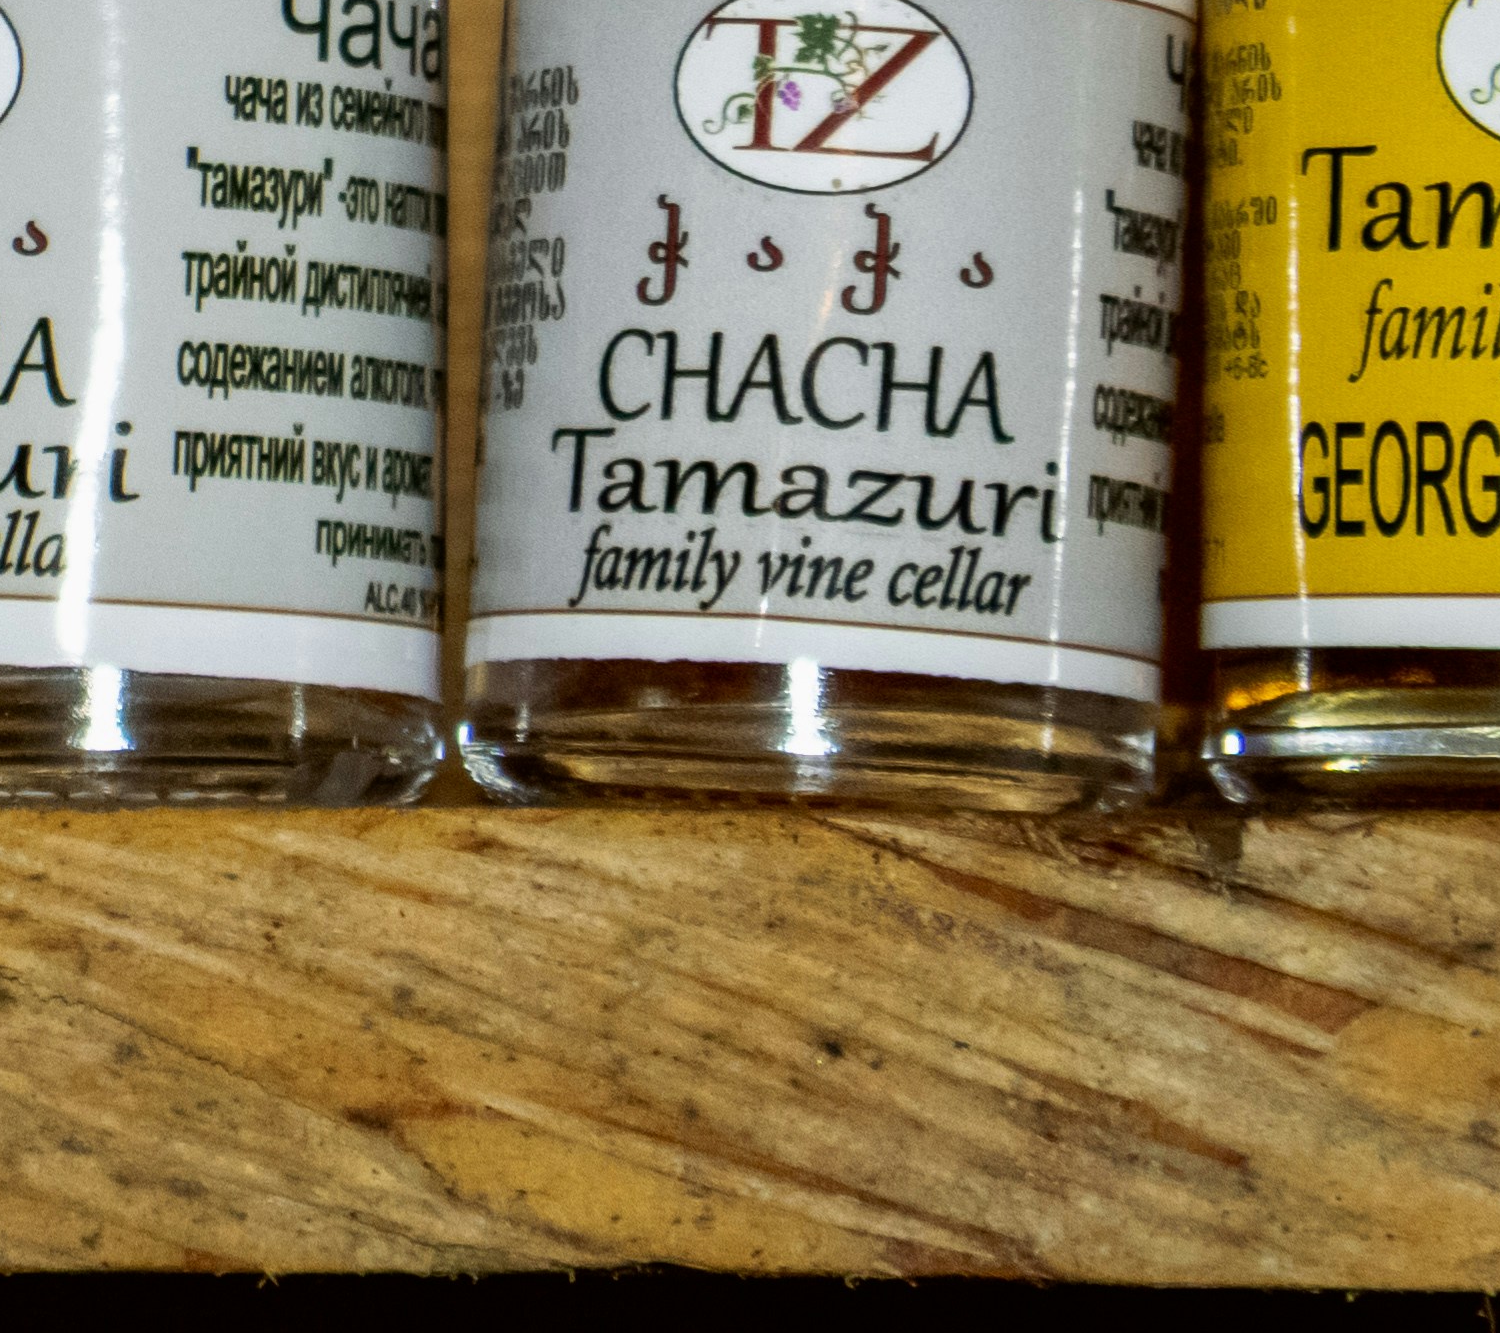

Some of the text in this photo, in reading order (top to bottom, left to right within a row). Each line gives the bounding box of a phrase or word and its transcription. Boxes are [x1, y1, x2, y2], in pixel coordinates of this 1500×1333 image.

[224, 73, 288, 124] чача
[295, 81, 324, 127] из
[186, 145, 334, 230] "тамазури"
[181, 240, 297, 310] трайной
[176, 339, 343, 400] содежанием
[600, 328, 1015, 446] CHACHA
[173, 423, 305, 491] приятний
[311, 437, 362, 501] вкус
[365, 444, 377, 490] и
[551, 427, 1065, 545] Tamazuri
[568, 523, 1032, 618] family vine cellar
